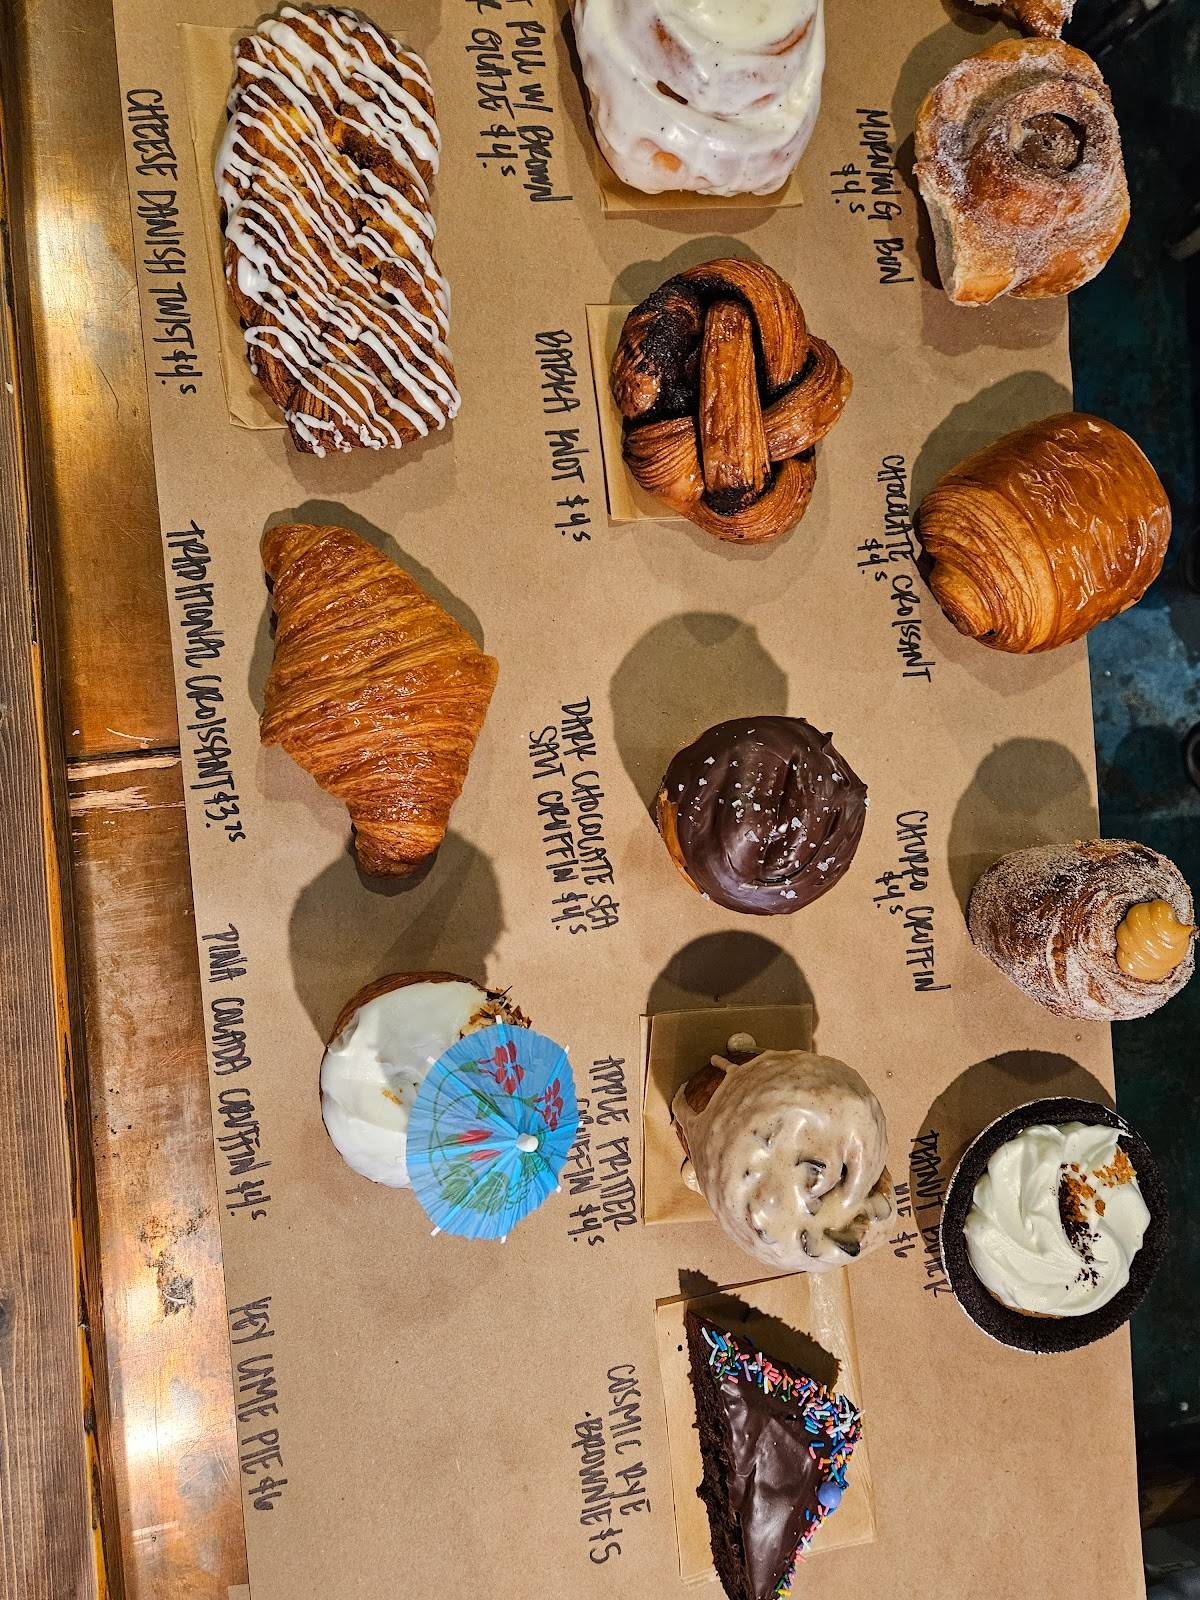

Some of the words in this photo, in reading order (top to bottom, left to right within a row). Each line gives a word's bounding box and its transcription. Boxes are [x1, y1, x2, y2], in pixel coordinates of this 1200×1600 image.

[465, 28, 515, 120] GLAZE
[506, 21, 546, 74] ROLL
[126, 88, 179, 181] CHEESE
[517, 125, 573, 202] BROWN
[856, 108, 901, 221] MORNING
[137, 190, 187, 275] DANISH
[874, 237, 914, 285] BUN
[149, 282, 194, 349] TWIST
[535, 329, 581, 414] BABKA
[545, 428, 589, 484] KNOT
[878, 455, 914, 562] CHOCOLATE
[166, 519, 226, 668] TRADITIONAL
[891, 575, 936, 683] CROISSANT
[185, 675, 235, 790] CROISSANT
[529, 726, 566, 780] SALT
[561, 696, 597, 762] DARK
[537, 790, 579, 883] CRUFFIN
[570, 771, 615, 885] CHOCOLATE
[896, 810, 929, 891] CHURRO
[585, 894, 620, 931] SEA
[904, 906, 951, 992] CRUFFIN
[211, 997, 251, 1076] COLADA
[589, 1055, 630, 1126] APPLE
[216, 1088, 272, 1176] CRUFFIN
[909, 1129, 946, 1211] PEANUT
[596, 1136, 638, 1232] FRITTER
[889, 1232, 918, 1258] $6
[229, 1296, 275, 1345] KEY
[237, 1354, 279, 1423] LIME
[607, 1364, 642, 1455] COSMIC
[240, 1429, 283, 1475] PIE
[610, 1462, 651, 1516] RYE
[248, 1476, 288, 1511] $6
